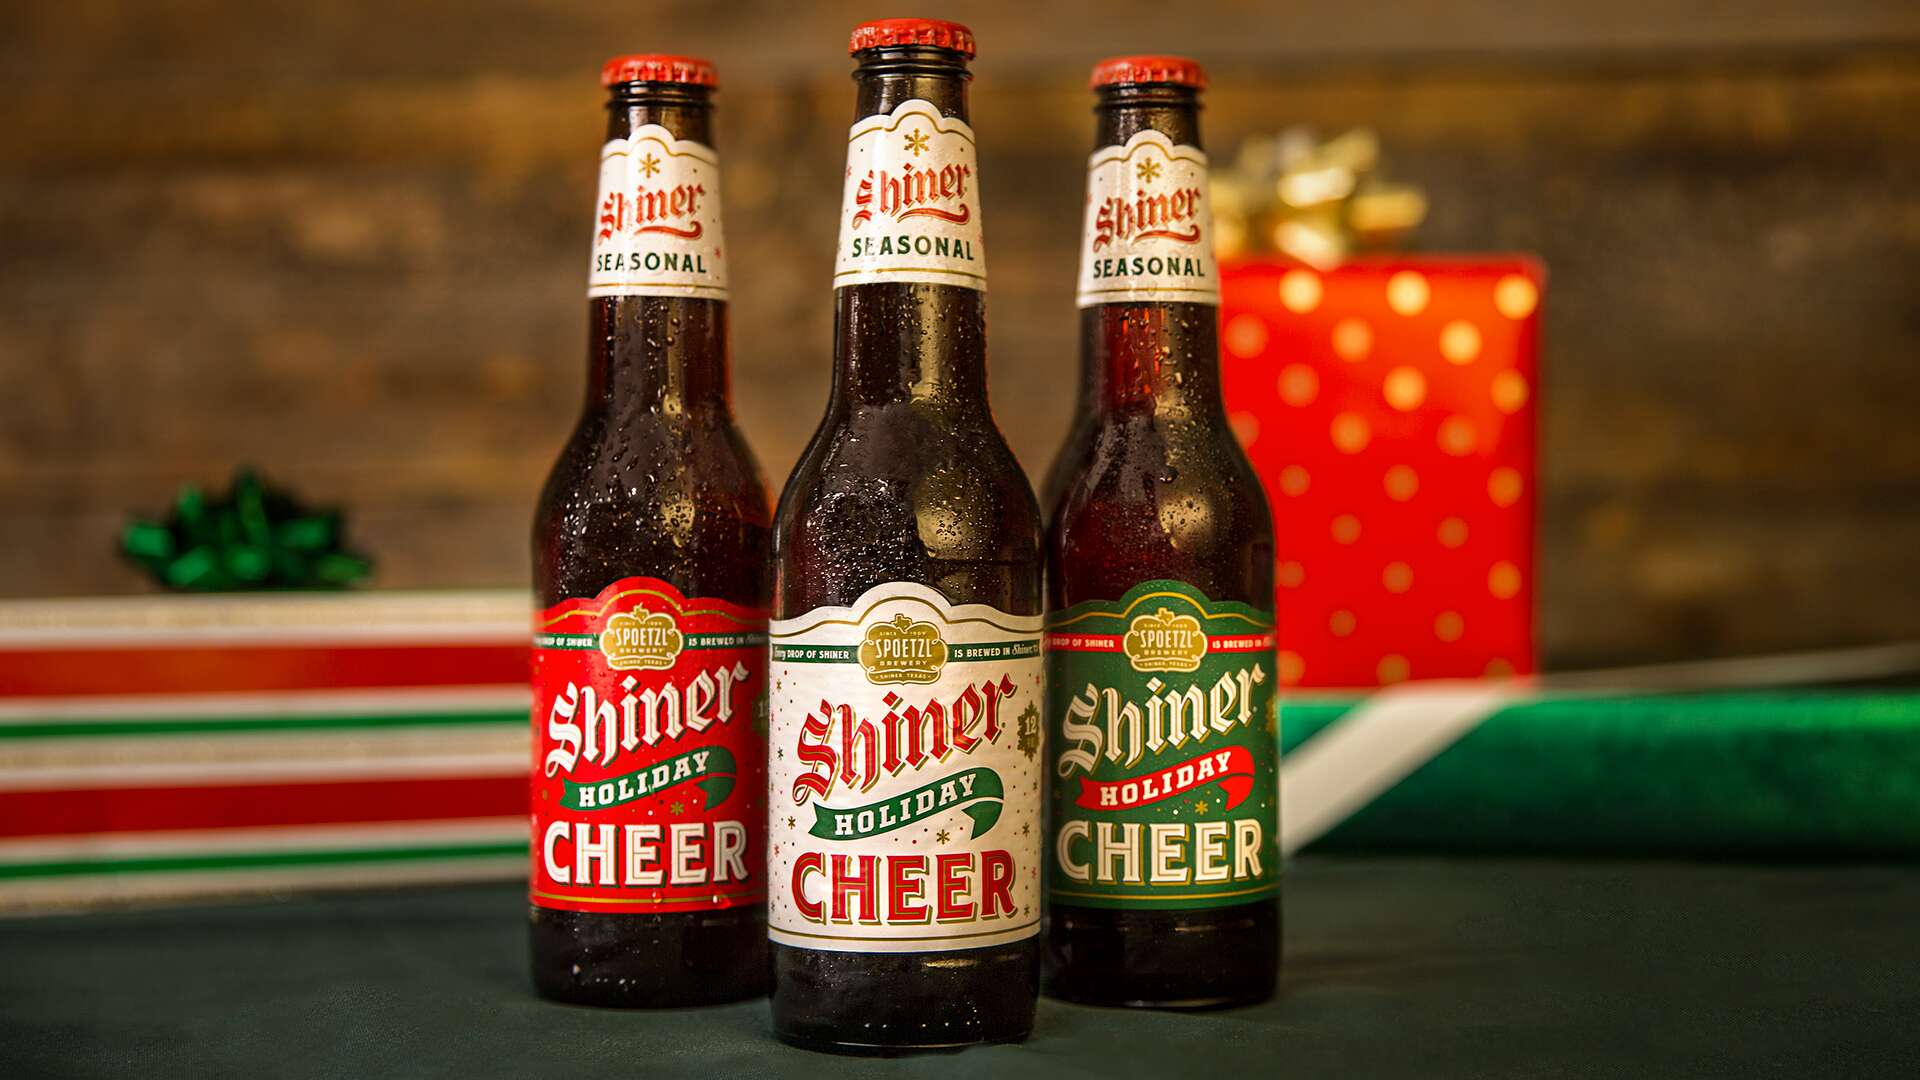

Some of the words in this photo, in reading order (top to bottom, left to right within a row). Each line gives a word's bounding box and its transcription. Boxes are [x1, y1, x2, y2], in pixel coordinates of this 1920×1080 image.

[853, 163, 970, 230] Shiner
[1093, 187, 1200, 252] Shiner
[597, 252, 707, 273] SEASONAL
[852, 235, 974, 260] SEASONAL
[1093, 257, 1205, 279] SEASONAL
[616, 628, 668, 646] SPOETZL
[688, 637, 698, 647] IS
[787, 649, 804, 658] DROP
[806, 649, 817, 659] OF
[819, 650, 849, 659] SHINER
[875, 638, 932, 658] SPOETZL
[954, 649, 964, 658] IS
[966, 647, 1001, 657] BREWED
[1002, 647, 1011, 656] IN
[1084, 639, 1115, 648] SHINER
[1140, 630, 1193, 648] SPOETZL
[545, 661, 750, 779] Shiner
[792, 673, 1018, 806] Shiner
[1058, 663, 1267, 778] Shiner
[578, 751, 710, 808] HOLIDAY
[834, 773, 977, 836] HOLIDAY
[1100, 751, 1232, 807] HOLIDAY
[543, 820, 749, 887] CHEER
[1056, 818, 1263, 886] CHEER
[791, 849, 1018, 926] CHEER
